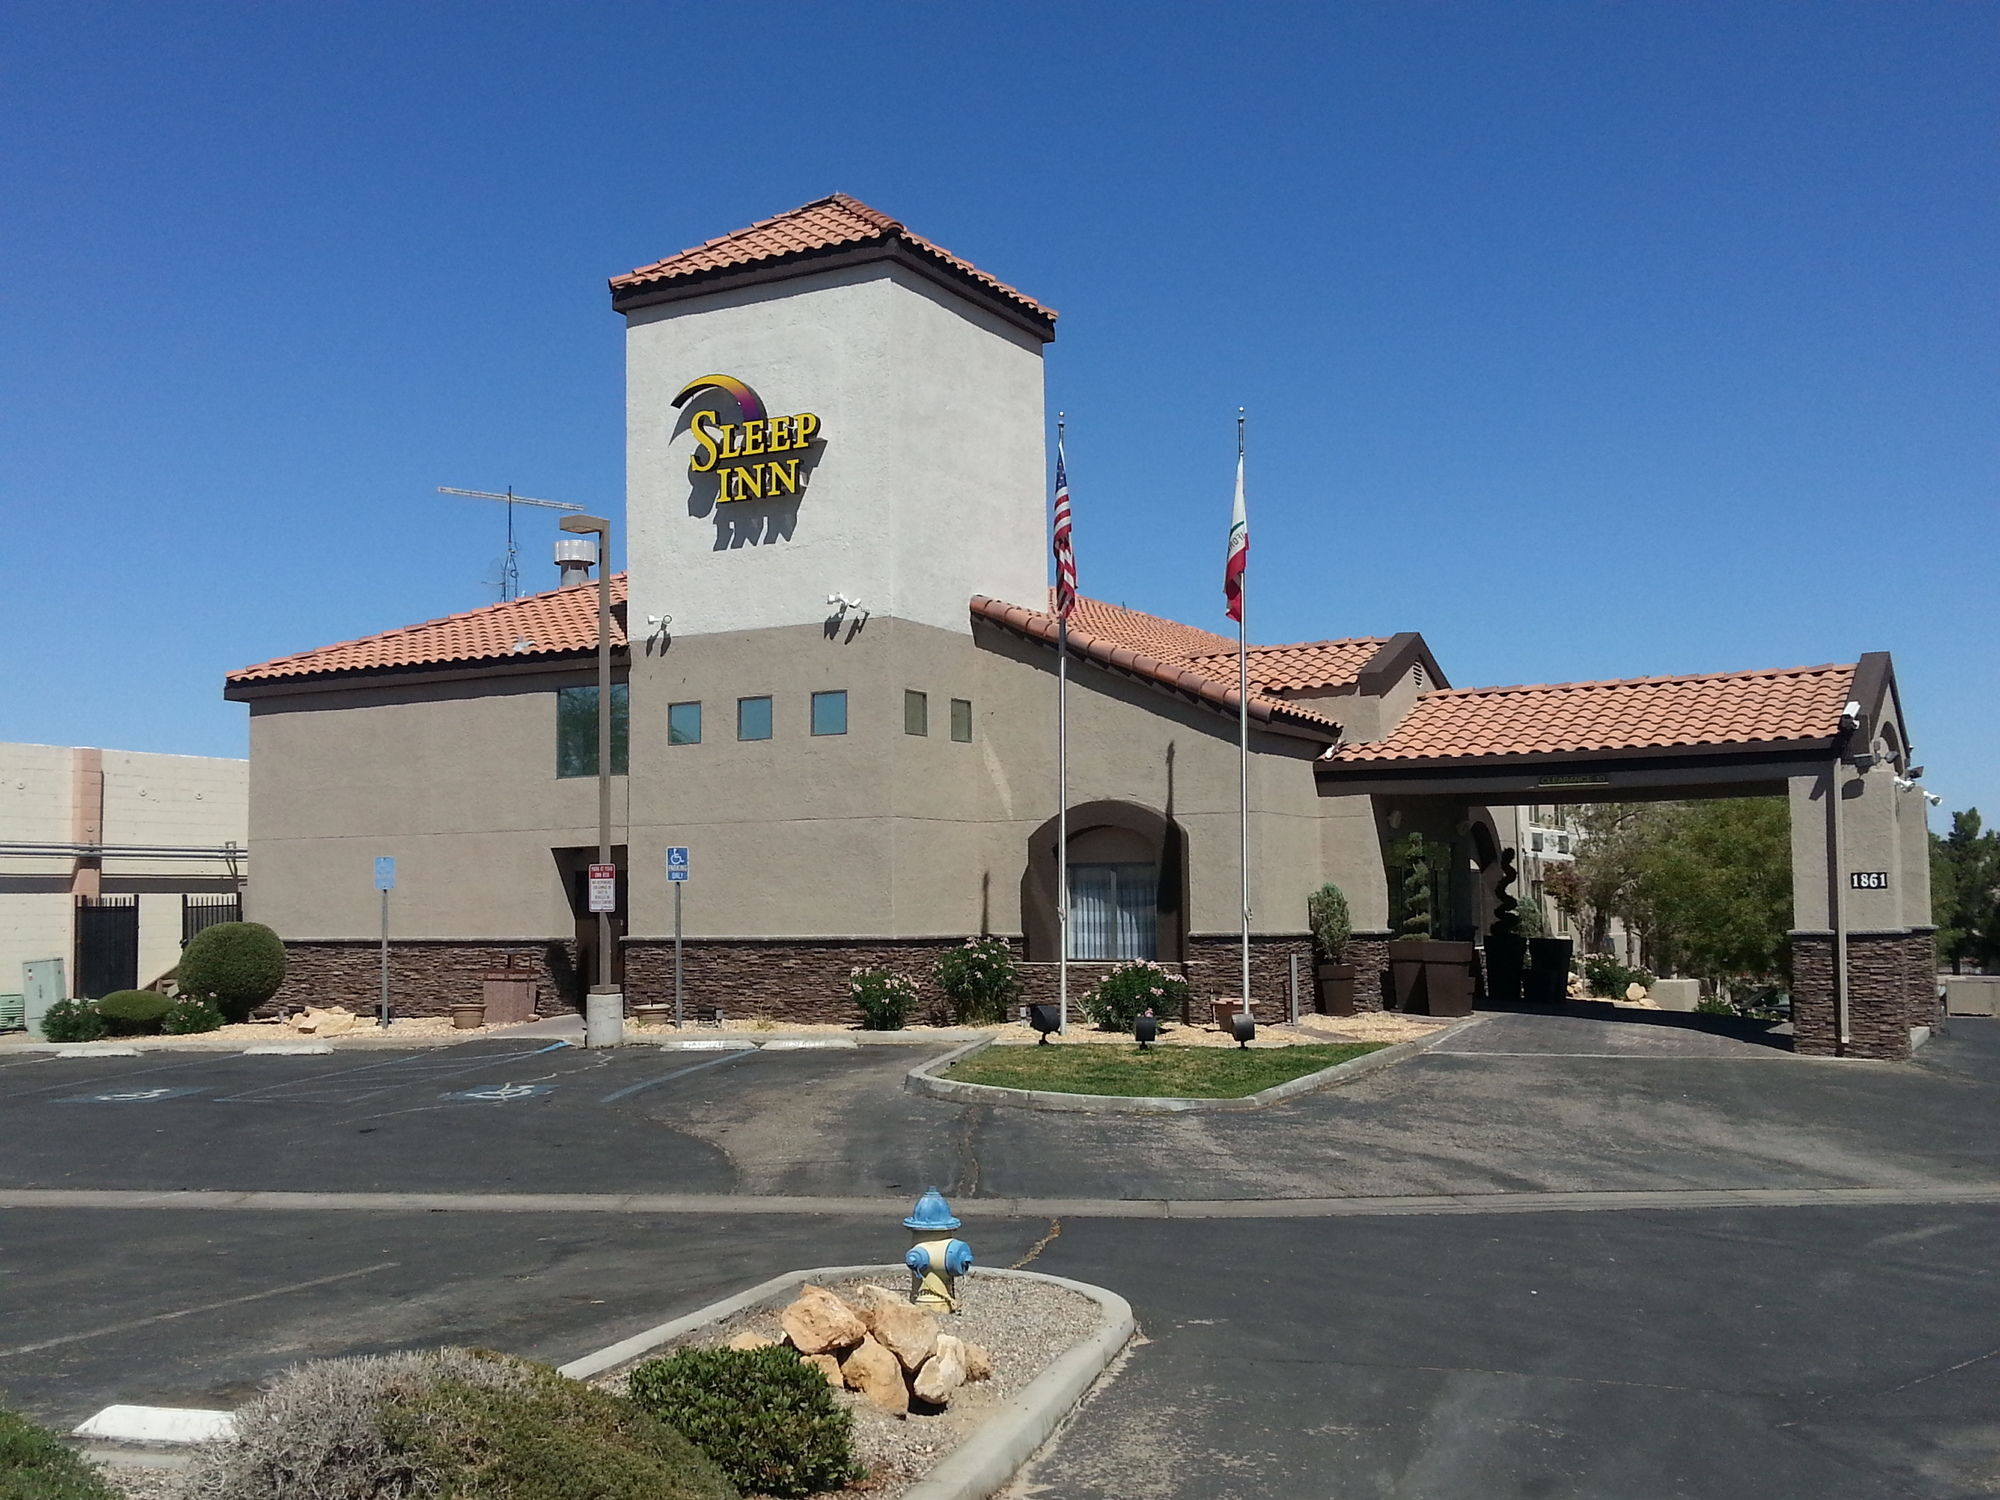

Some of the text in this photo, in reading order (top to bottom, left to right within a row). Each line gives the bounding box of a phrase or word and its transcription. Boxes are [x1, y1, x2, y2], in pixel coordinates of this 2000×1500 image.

[690, 411, 818, 472] SLEEP
[716, 459, 801, 503] INN
[1852, 873, 1886, 888] 1861
